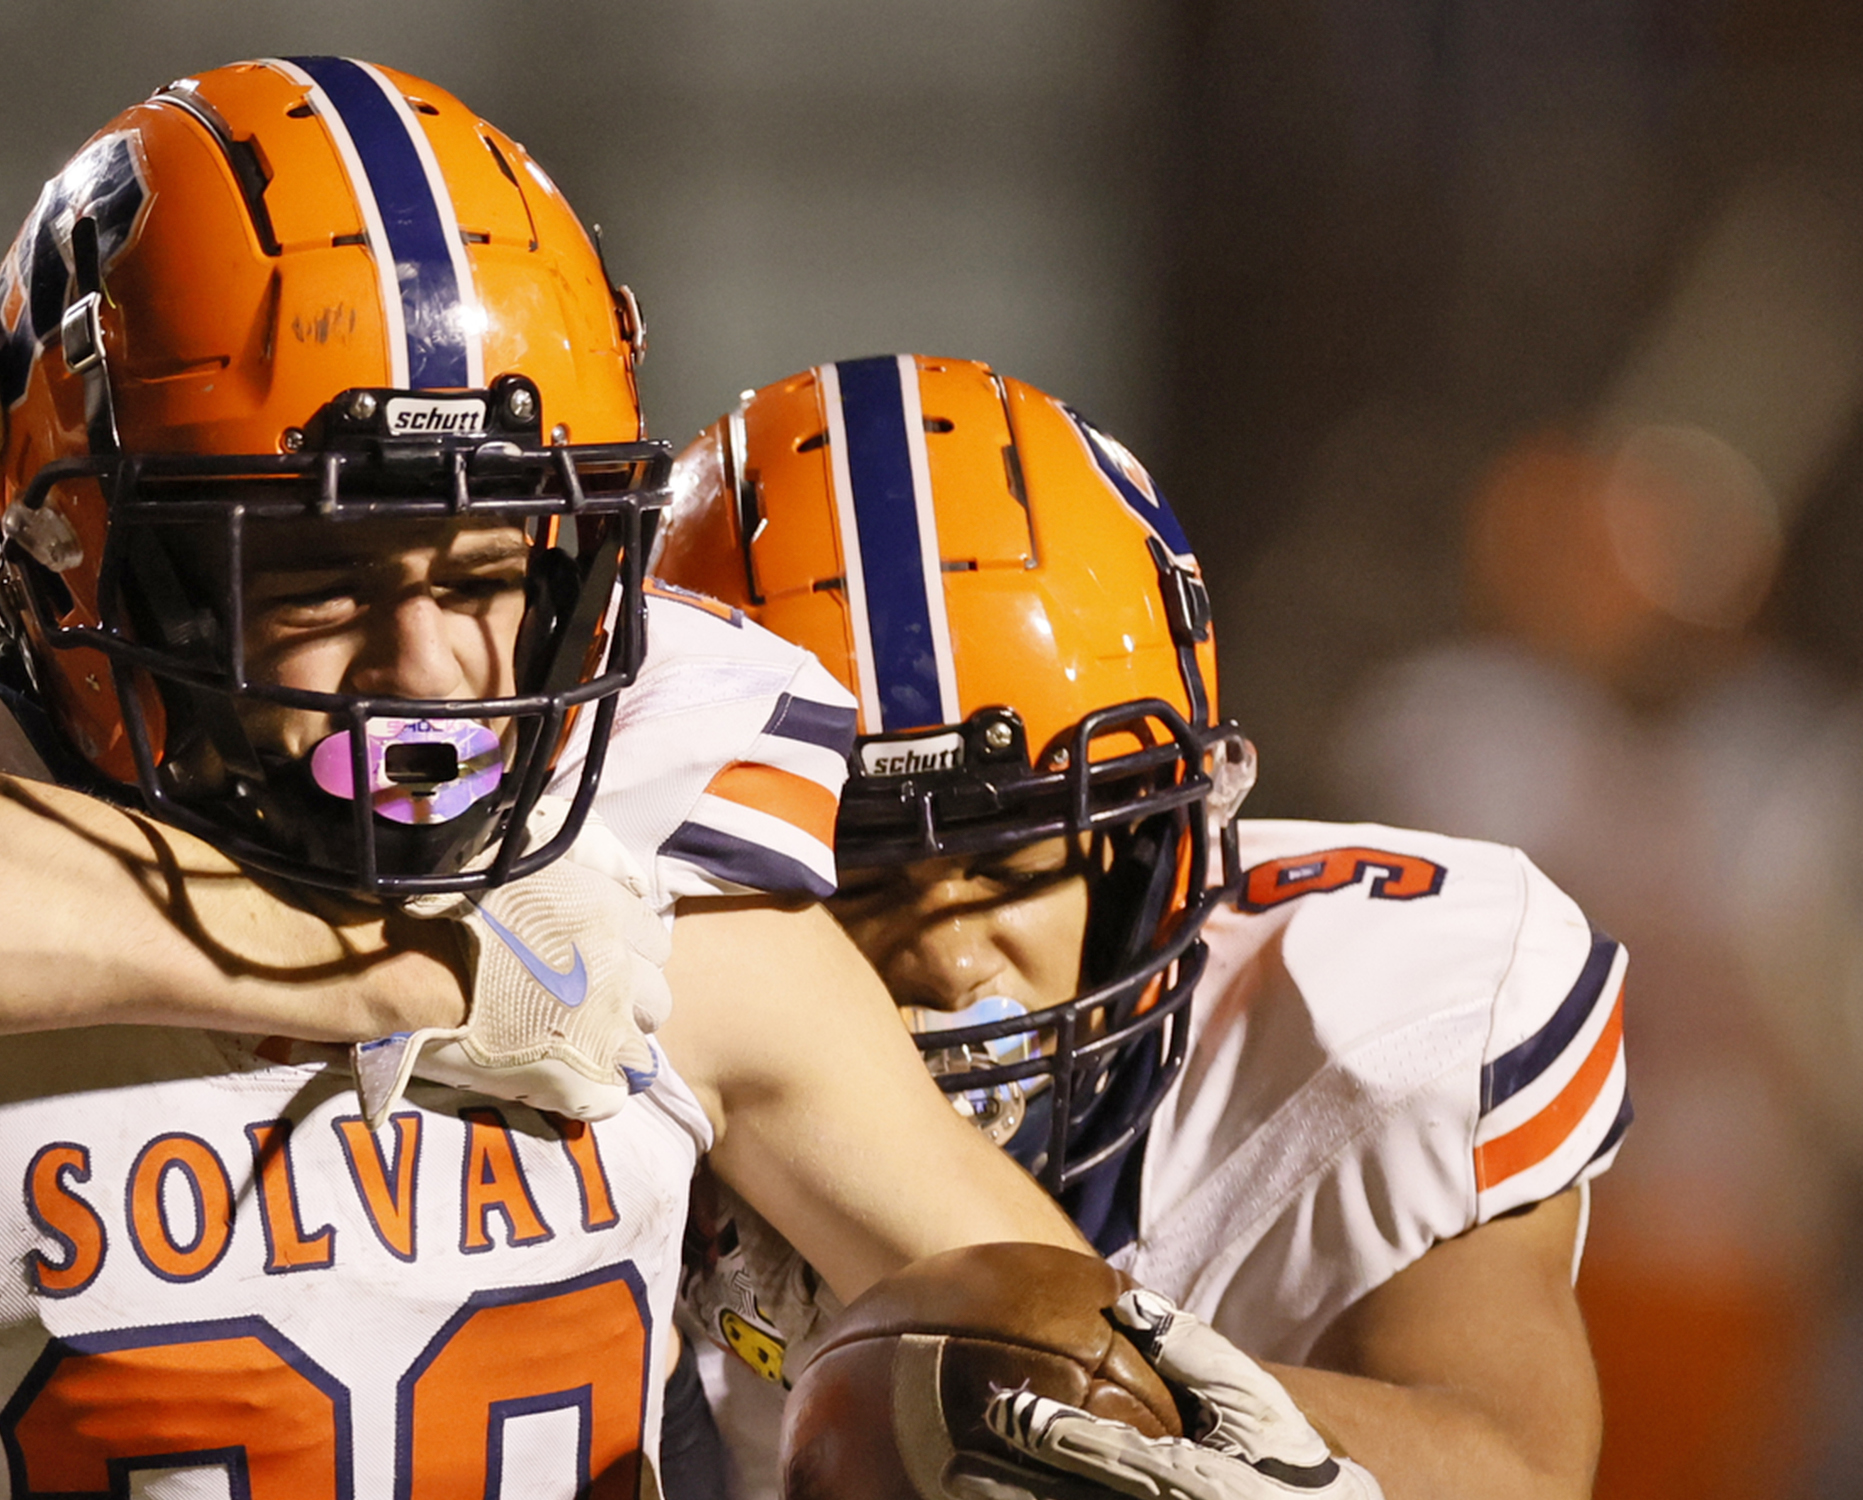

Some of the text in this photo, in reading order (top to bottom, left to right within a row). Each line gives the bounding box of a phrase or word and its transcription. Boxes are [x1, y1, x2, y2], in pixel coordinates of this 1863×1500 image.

[393, 406, 480, 431] schutt
[872, 746, 960, 775] schutt
[23, 1106, 620, 1298] SOLVAY
